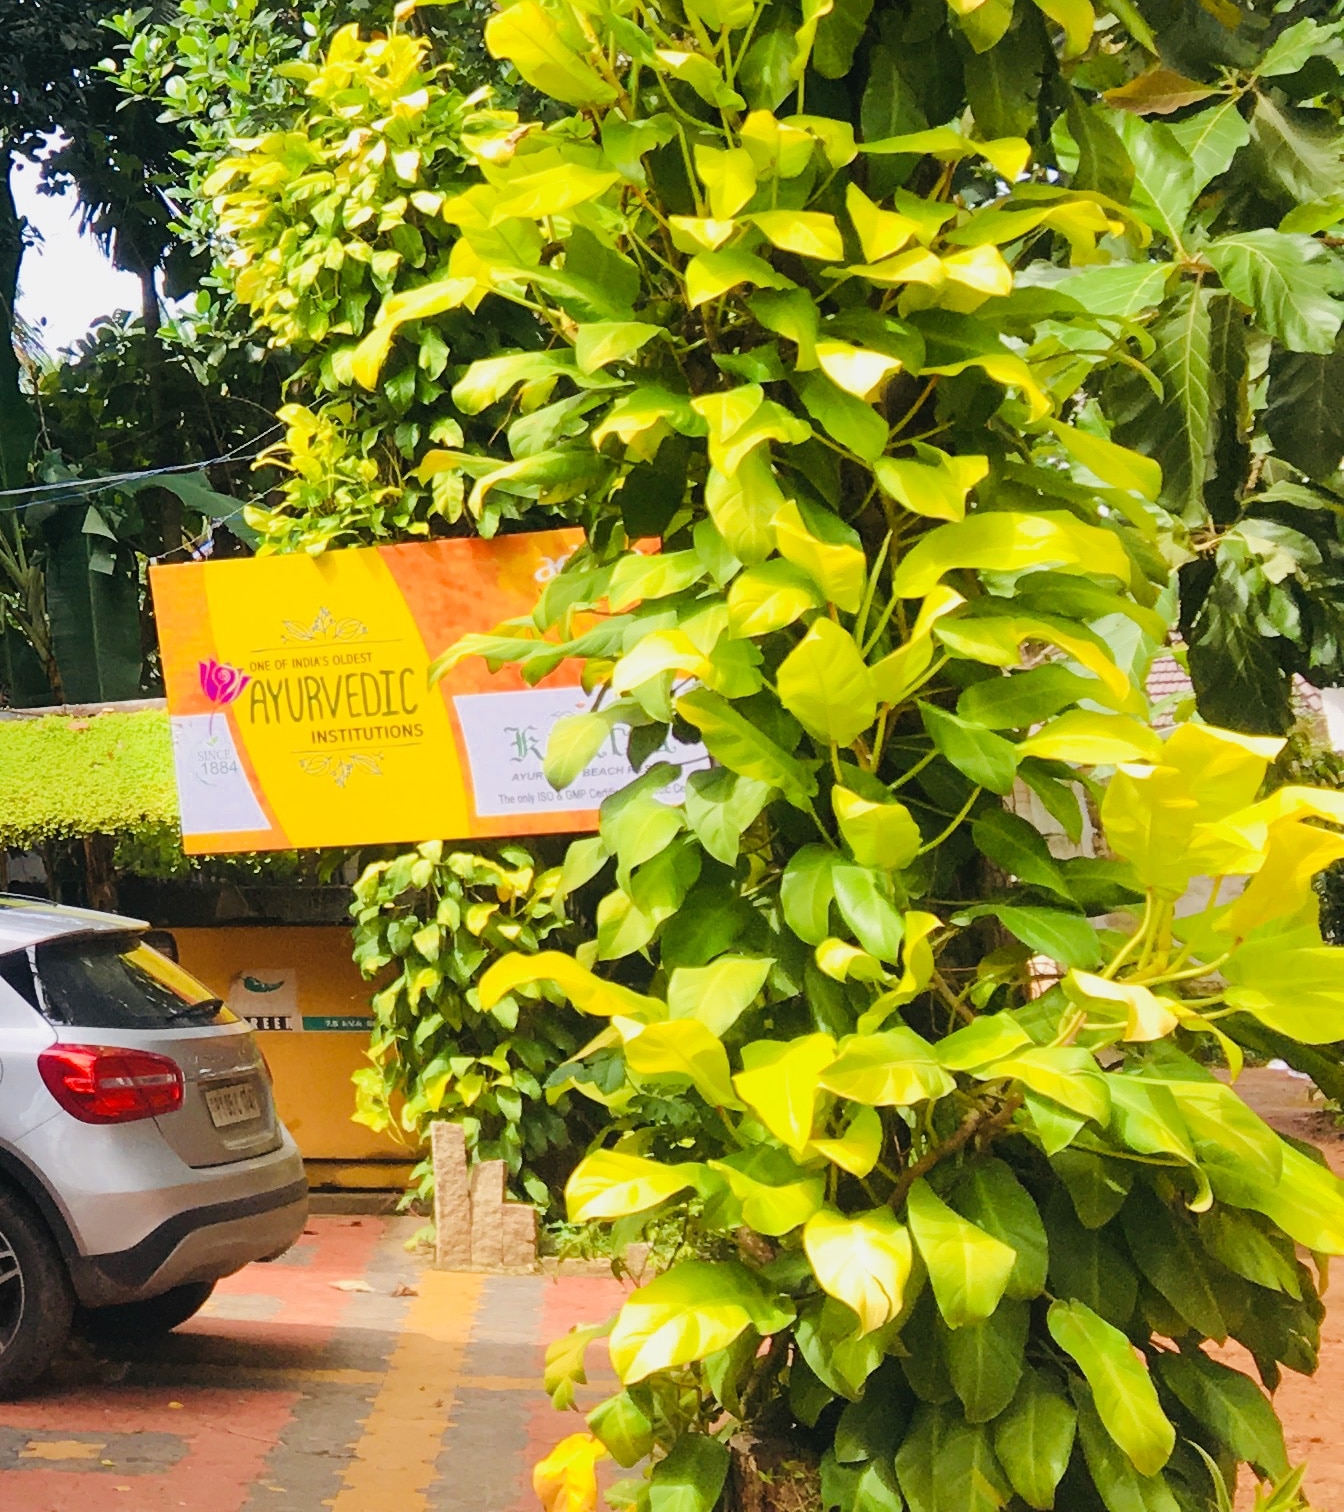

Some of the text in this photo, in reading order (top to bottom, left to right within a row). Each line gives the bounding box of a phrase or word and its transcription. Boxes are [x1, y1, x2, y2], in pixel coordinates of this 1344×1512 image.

[250, 652, 372, 673] ONE OF INDIA'S OLDEST
[250, 668, 419, 725] AYURVEDIC
[311, 723, 424, 744] INSTITUTIONS
[197, 748, 231, 762] SINCE
[201, 760, 239, 776] 1884
[582, 766, 624, 778] BEACH
[498, 793, 515, 804] The
[517, 792, 535, 805] only
[537, 791, 554, 802] ISO
[565, 789, 586, 800] GMP
